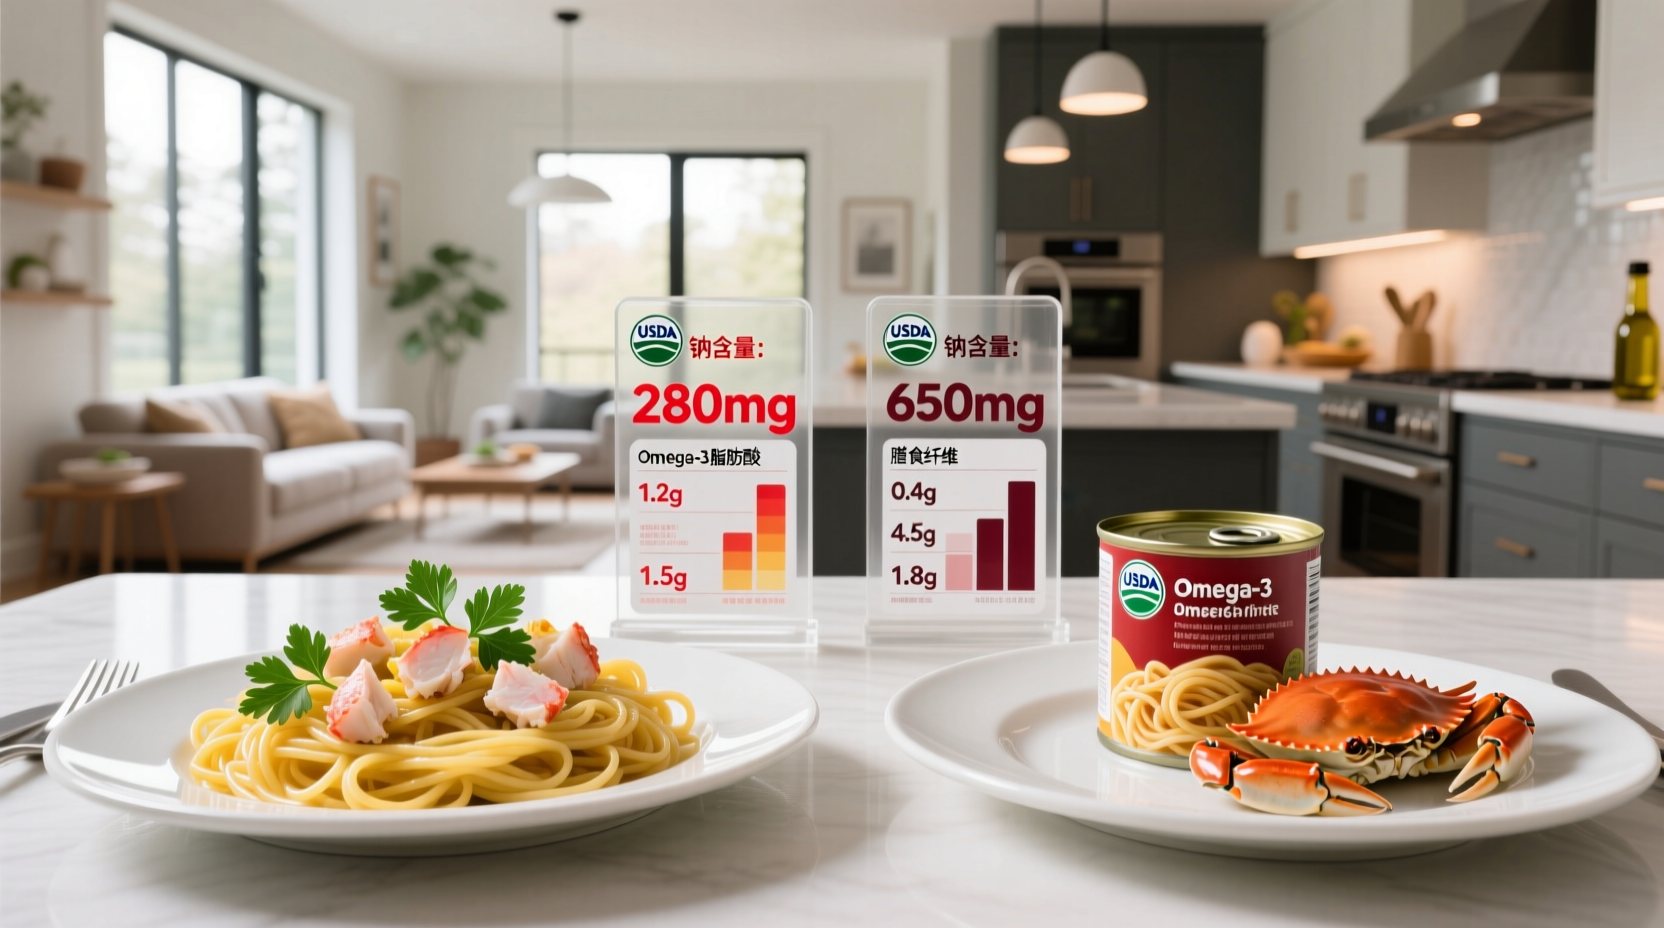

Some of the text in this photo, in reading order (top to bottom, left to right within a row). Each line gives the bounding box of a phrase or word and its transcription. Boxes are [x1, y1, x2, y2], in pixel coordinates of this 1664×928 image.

[637, 324, 677, 339] USDA
[890, 323, 932, 339] USDA
[632, 383, 796, 435] 280mg
[886, 382, 1044, 433] 650mg
[638, 483, 683, 507] 1.2g
[891, 481, 937, 506] 0.4g
[891, 522, 936, 547] 4.5g
[640, 566, 687, 591] 1.5g
[891, 565, 937, 590] 1.8g
[1123, 571, 1160, 592] USDA
[1174, 578, 1272, 605] Omega-3
